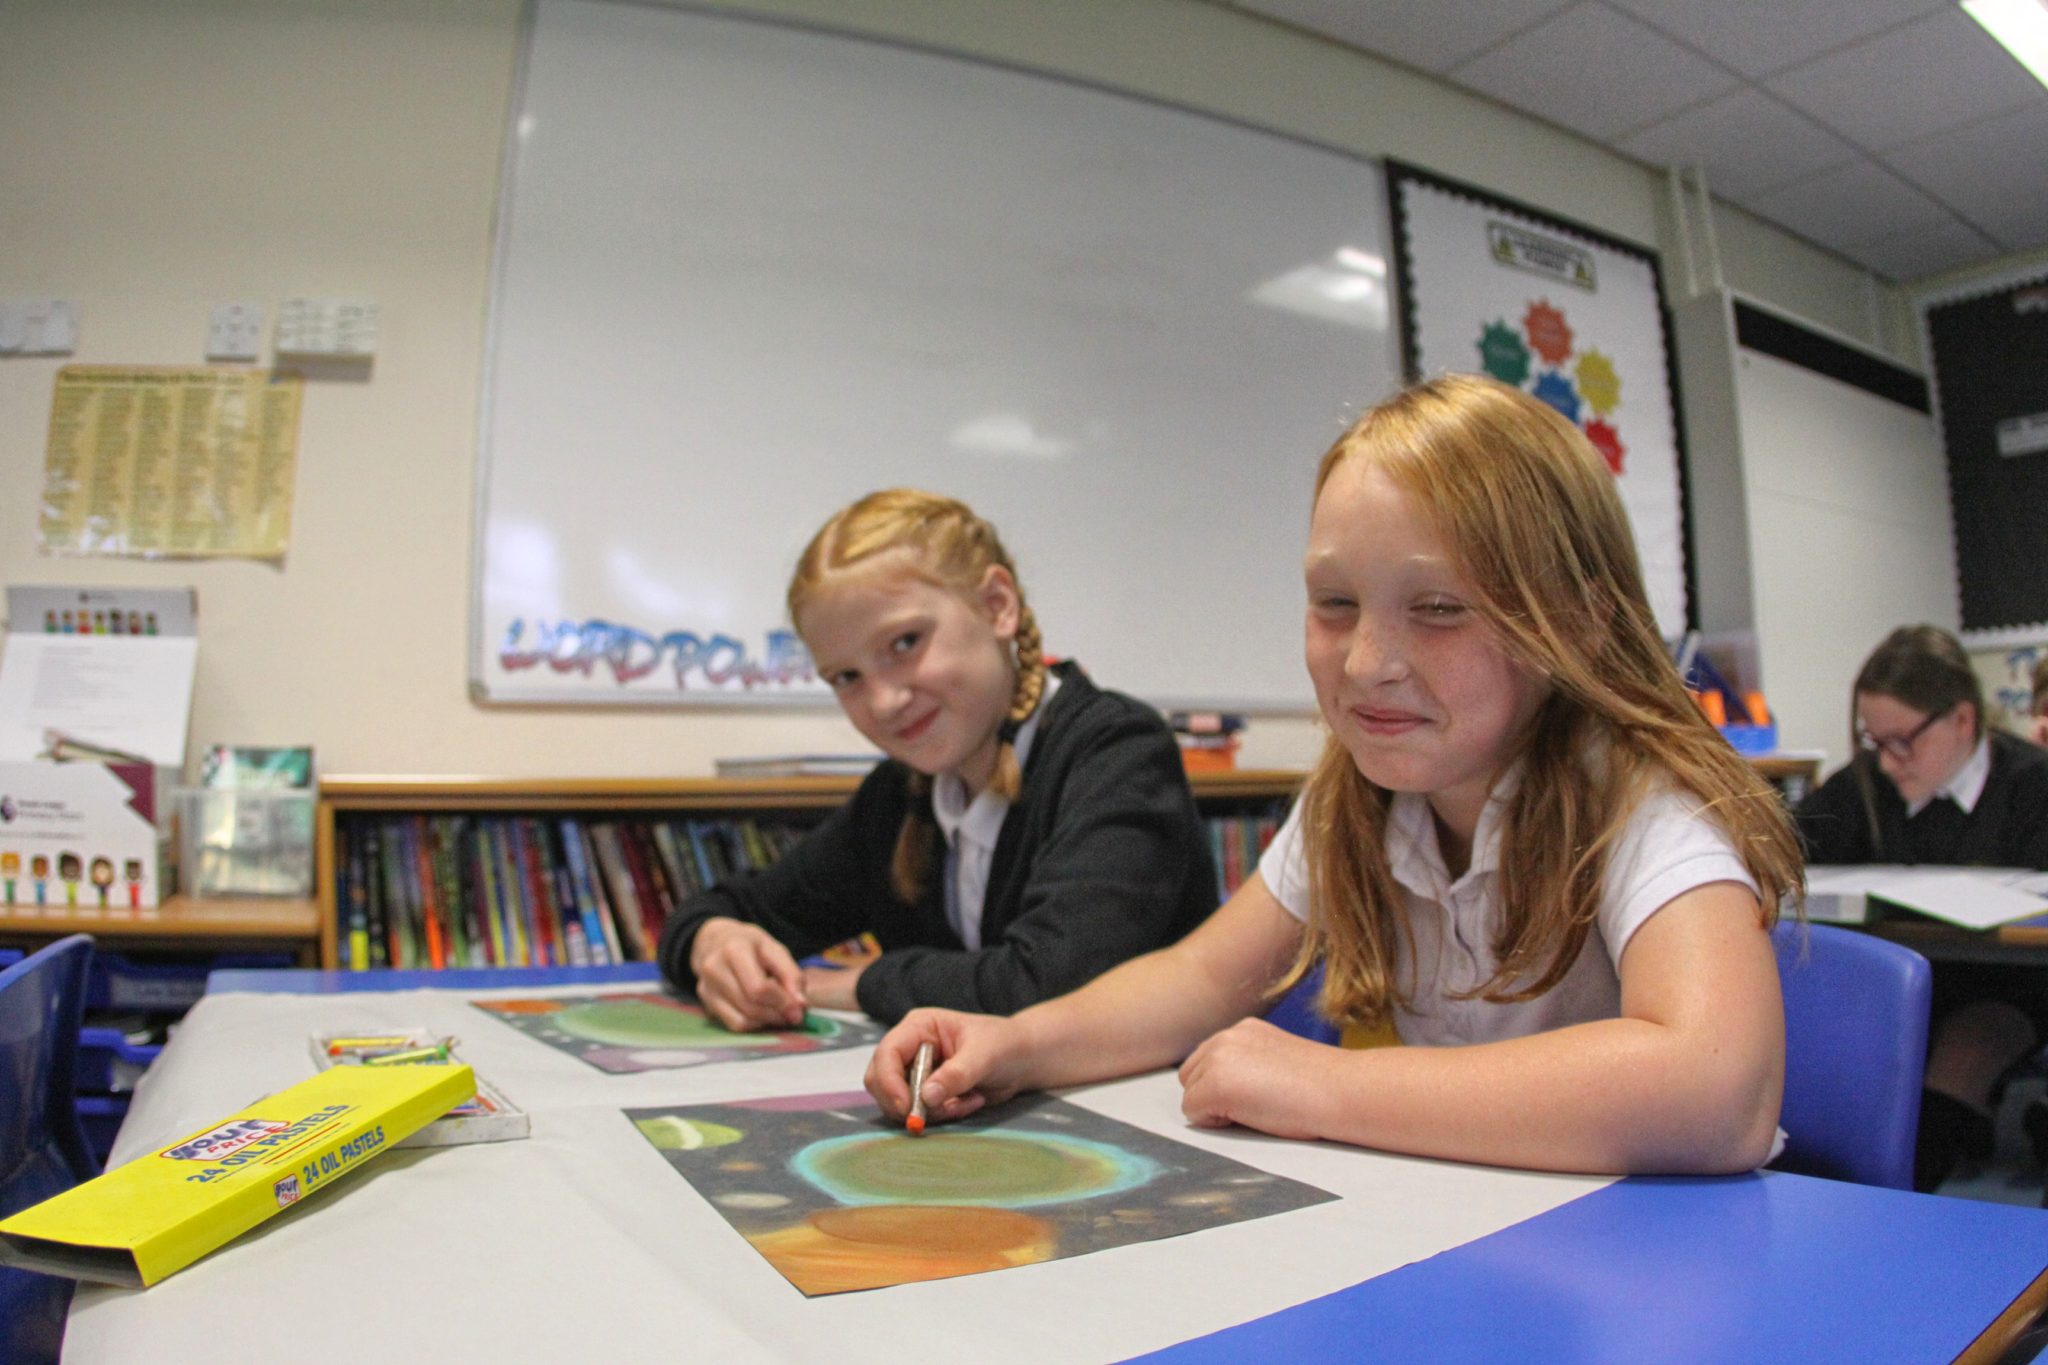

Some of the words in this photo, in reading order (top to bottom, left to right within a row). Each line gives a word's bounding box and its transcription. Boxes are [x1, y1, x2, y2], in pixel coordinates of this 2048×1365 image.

[186, 1168, 227, 1183] 24
[220, 1148, 269, 1166] OIL
[258, 1104, 350, 1147] PASTELS
[207, 1125, 288, 1154] PRICE
[303, 1161, 319, 1184] 24
[320, 1151, 340, 1174] OIL
[340, 1125, 385, 1163] PASTELS
